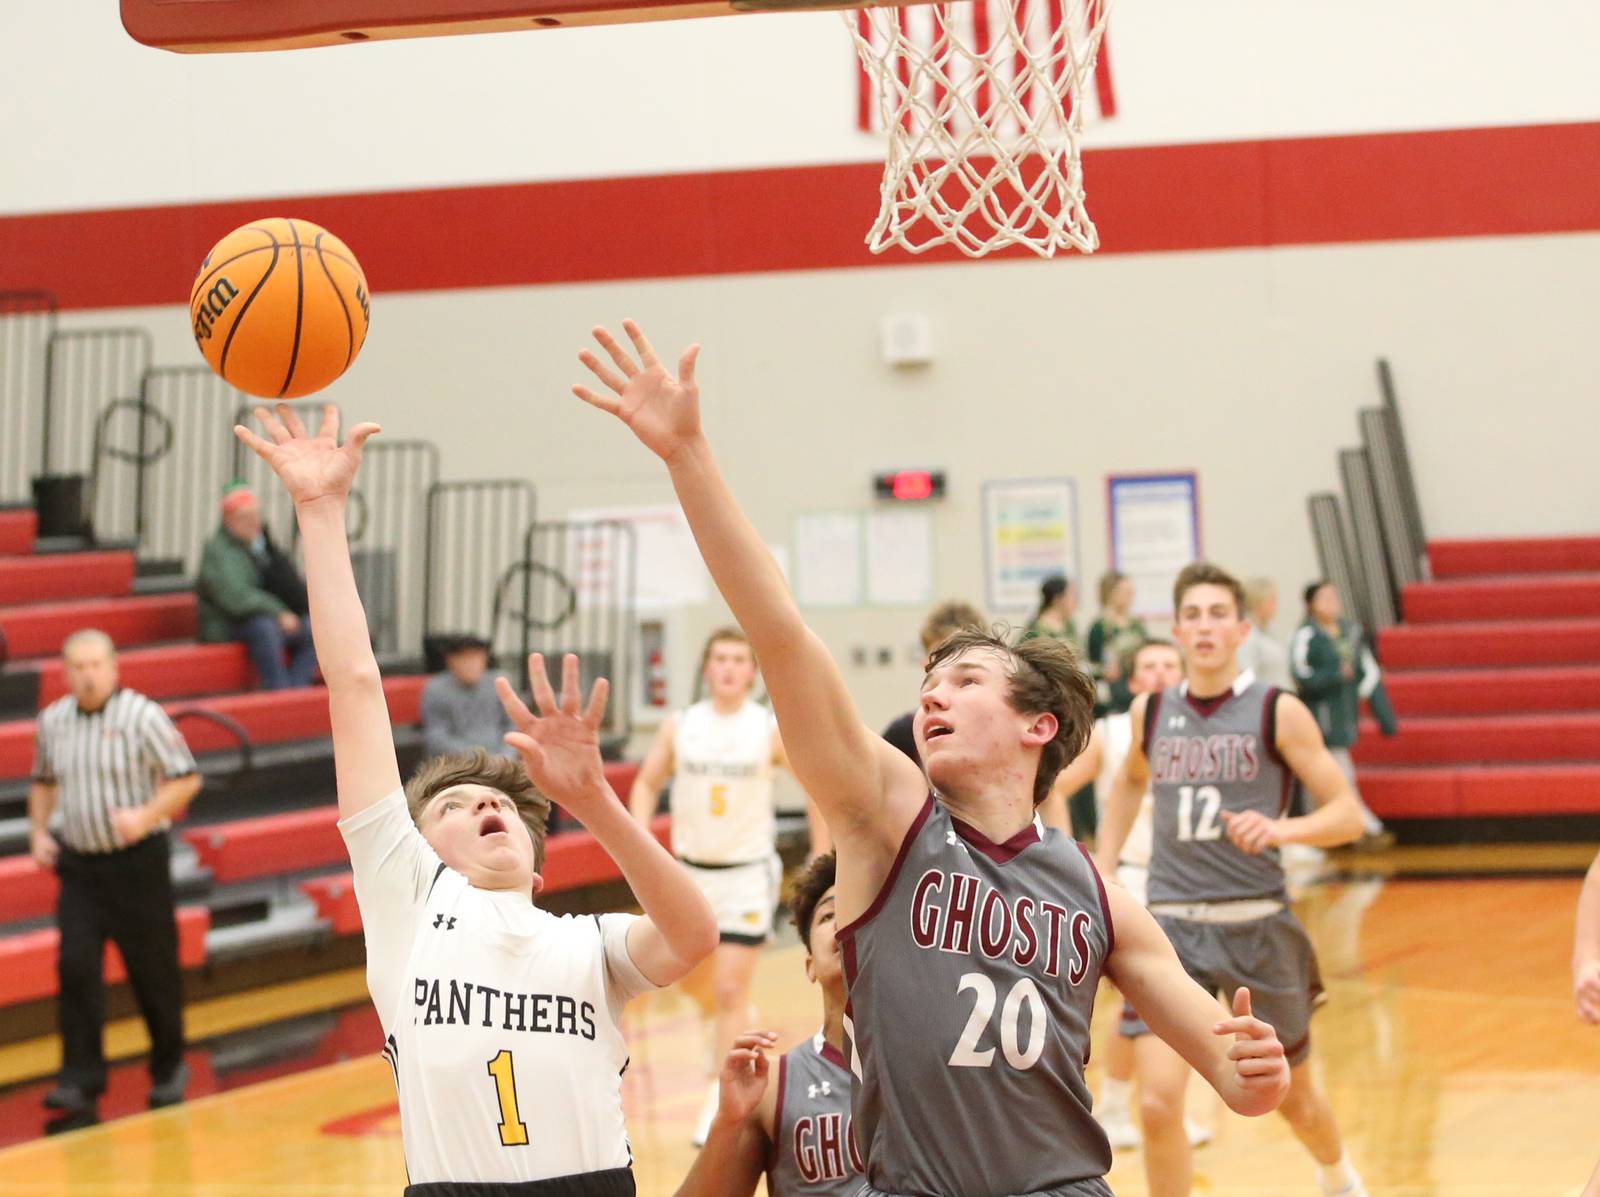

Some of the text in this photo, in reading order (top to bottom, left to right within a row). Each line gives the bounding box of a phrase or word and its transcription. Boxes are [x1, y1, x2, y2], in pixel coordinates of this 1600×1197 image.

[1150, 733, 1260, 785] GHOSTS
[709, 783, 730, 817] 5
[1177, 784, 1222, 841] 12
[910, 868, 1091, 986] GHOSTS
[414, 977, 596, 1041] PANTHERS
[947, 972, 1048, 1071] 20
[487, 1049, 530, 1147] 1
